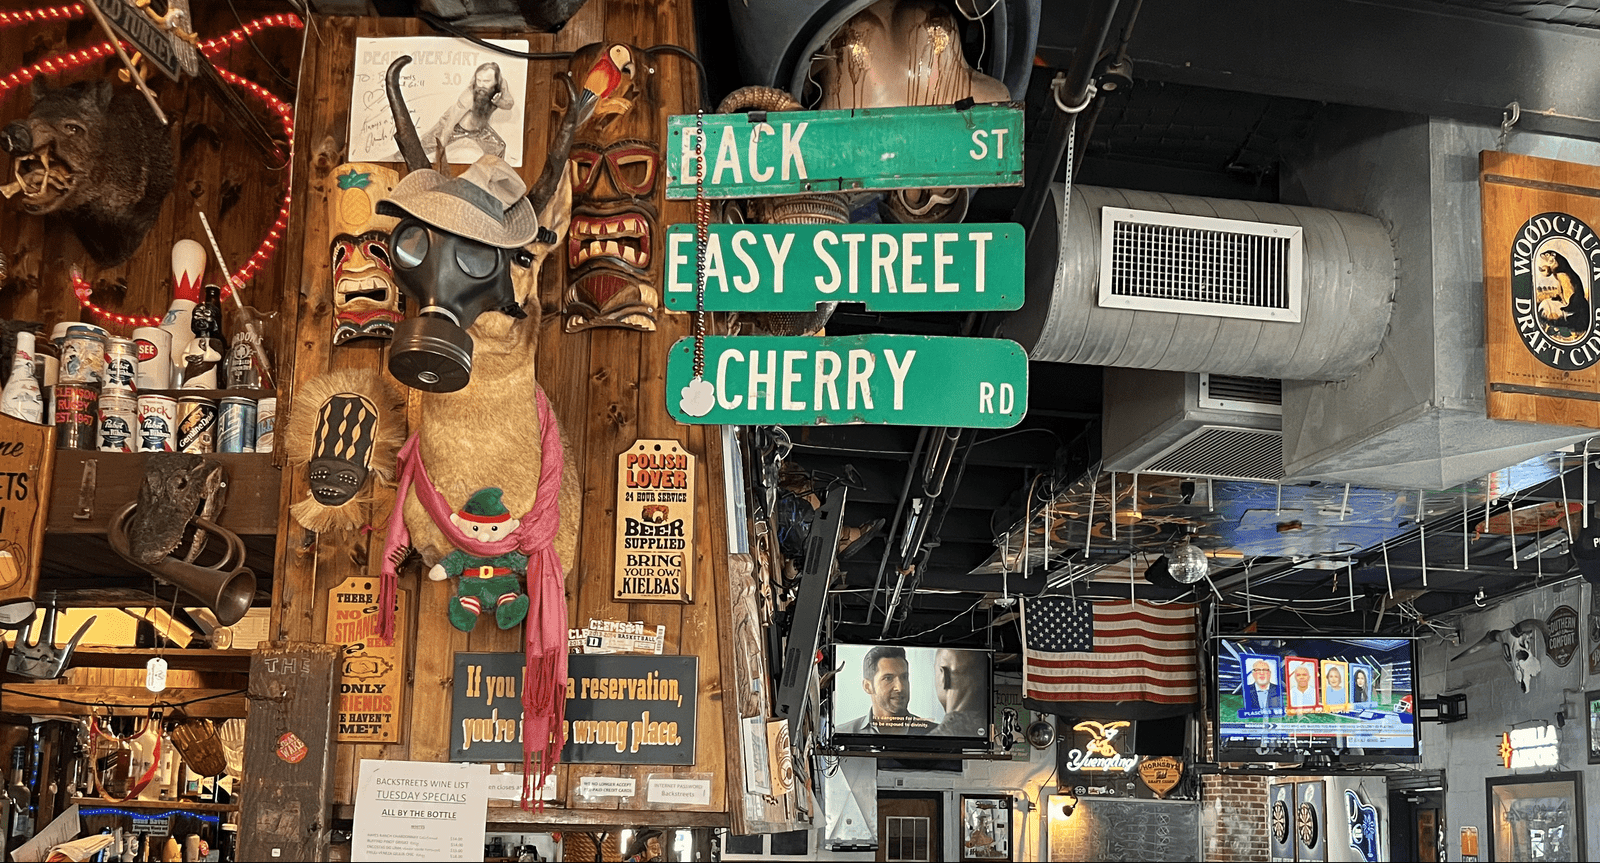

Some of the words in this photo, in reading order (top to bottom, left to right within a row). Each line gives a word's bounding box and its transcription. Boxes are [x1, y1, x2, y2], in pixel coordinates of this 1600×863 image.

[121, 5, 176, 70] TURKEY
[442, 73, 462, 86] 3.0
[680, 122, 809, 185] BACK
[969, 128, 1009, 160] ST
[668, 230, 795, 293] EASY
[813, 230, 993, 294] STREET
[1515, 297, 1565, 366] DRAFT
[138, 344, 155, 354] SEE
[716, 348, 917, 411] CHERRY
[979, 381, 1015, 415] RD
[55, 387, 97, 401] CLEMSON
[58, 399, 89, 411] RUGBY
[627, 454, 687, 470] POLISH
[626, 470, 687, 489] LOVER
[625, 492, 634, 501] 24
[636, 492, 656, 501] HOUR
[657, 492, 687, 502] SERVICE
[625, 518, 684, 537] BEER
[624, 538, 686, 549] SUPPLIED
[627, 555, 682, 567] BRING
[624, 568, 654, 577] YOUR
[623, 577, 680, 595] KIELBAS
[336, 593, 373, 604] THERE
[336, 610, 361, 620] NO
[1549, 633, 1575, 650] COMFORT
[264, 657, 310, 675] THE
[340, 684, 386, 694] ONLY
[467, 665, 482, 698] If
[486, 676, 515, 706] you
[566, 678, 576, 699] a
[580, 671, 683, 708] reservation,
[340, 695, 392, 712] RIENDS
[349, 713, 392, 723] HAVEN'T
[339, 724, 382, 734] MET
[462, 708, 516, 750] you're
[573, 720, 628, 753] wrong
[630, 711, 682, 753] place.
[1066, 749, 1139, 772] Yuengling
[376, 778, 428, 788] BACKSTREETS
[430, 780, 451, 789] WINE
[454, 781, 469, 789] LIST
[377, 790, 420, 800] TUESDAY
[422, 791, 467, 803] SPECIALS
[661, 790, 695, 798] Backstreets
[397, 809, 408, 817] BY
[427, 811, 457, 819] BOTTLE
